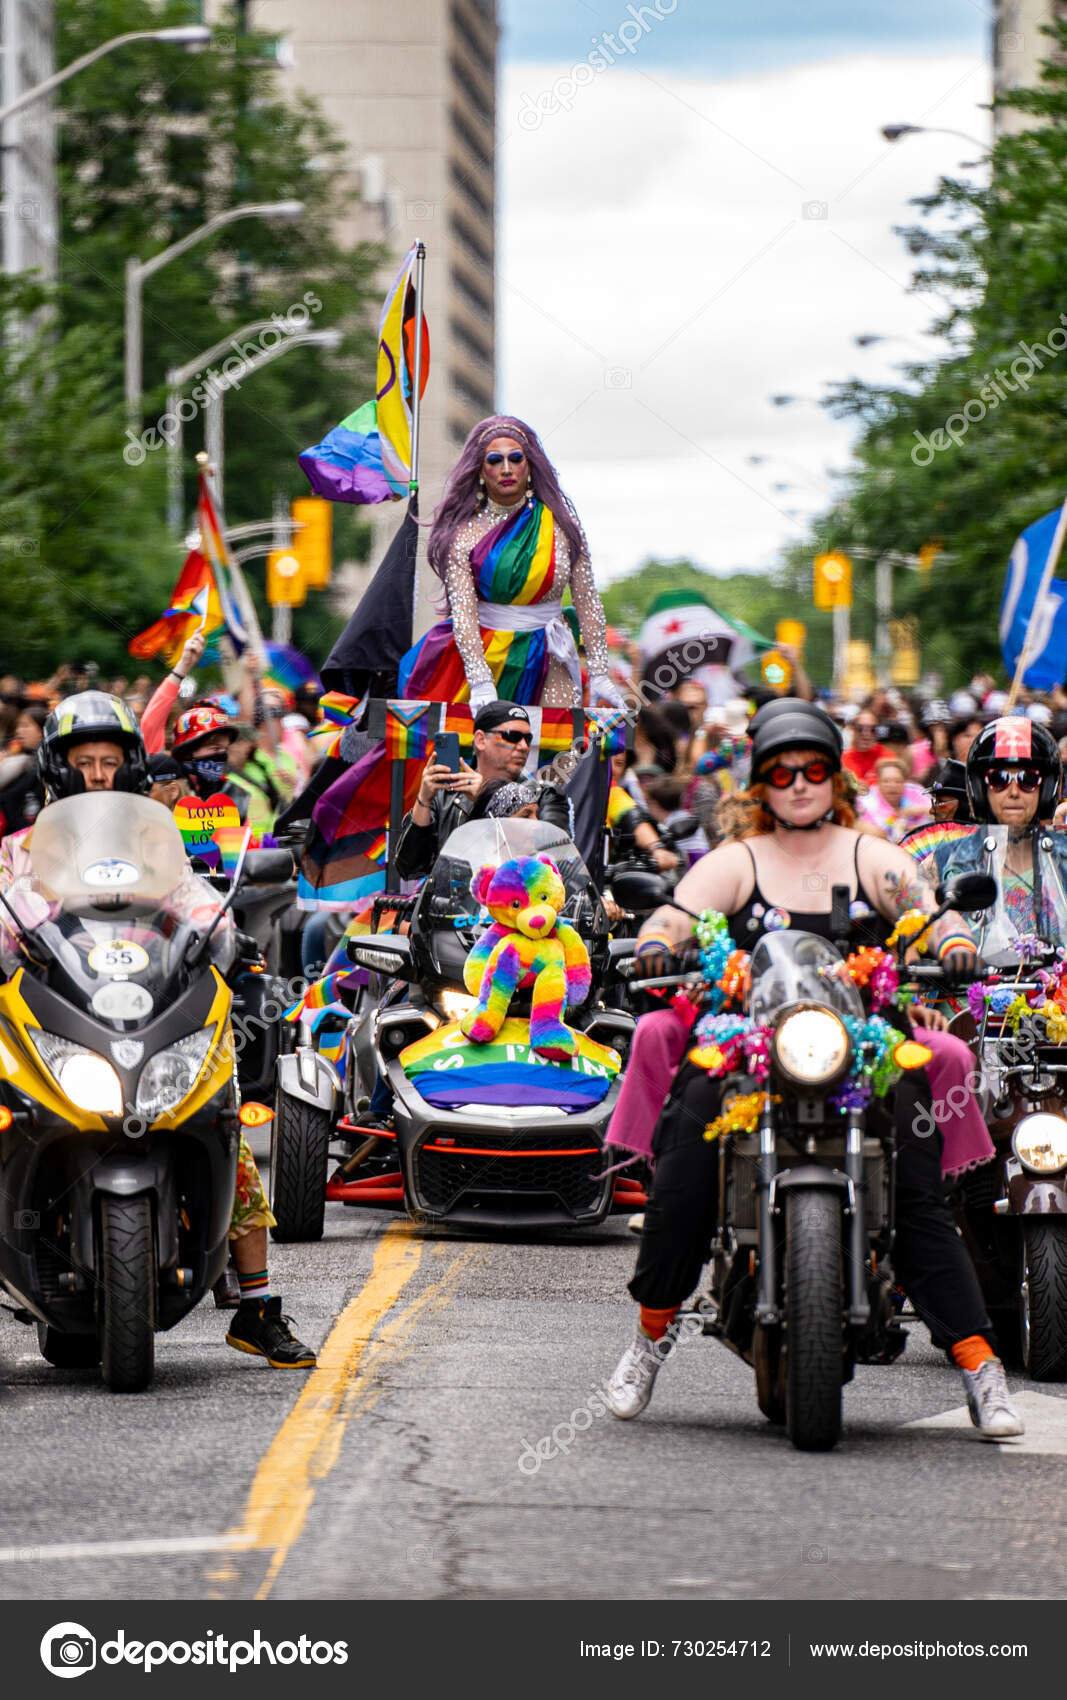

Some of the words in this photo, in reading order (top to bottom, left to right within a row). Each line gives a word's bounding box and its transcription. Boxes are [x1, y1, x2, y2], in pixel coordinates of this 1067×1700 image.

[187, 806, 225, 819] LOVE
[201, 820, 215, 832] IS
[191, 833, 213, 846] LO
[106, 951, 133, 965] 55
